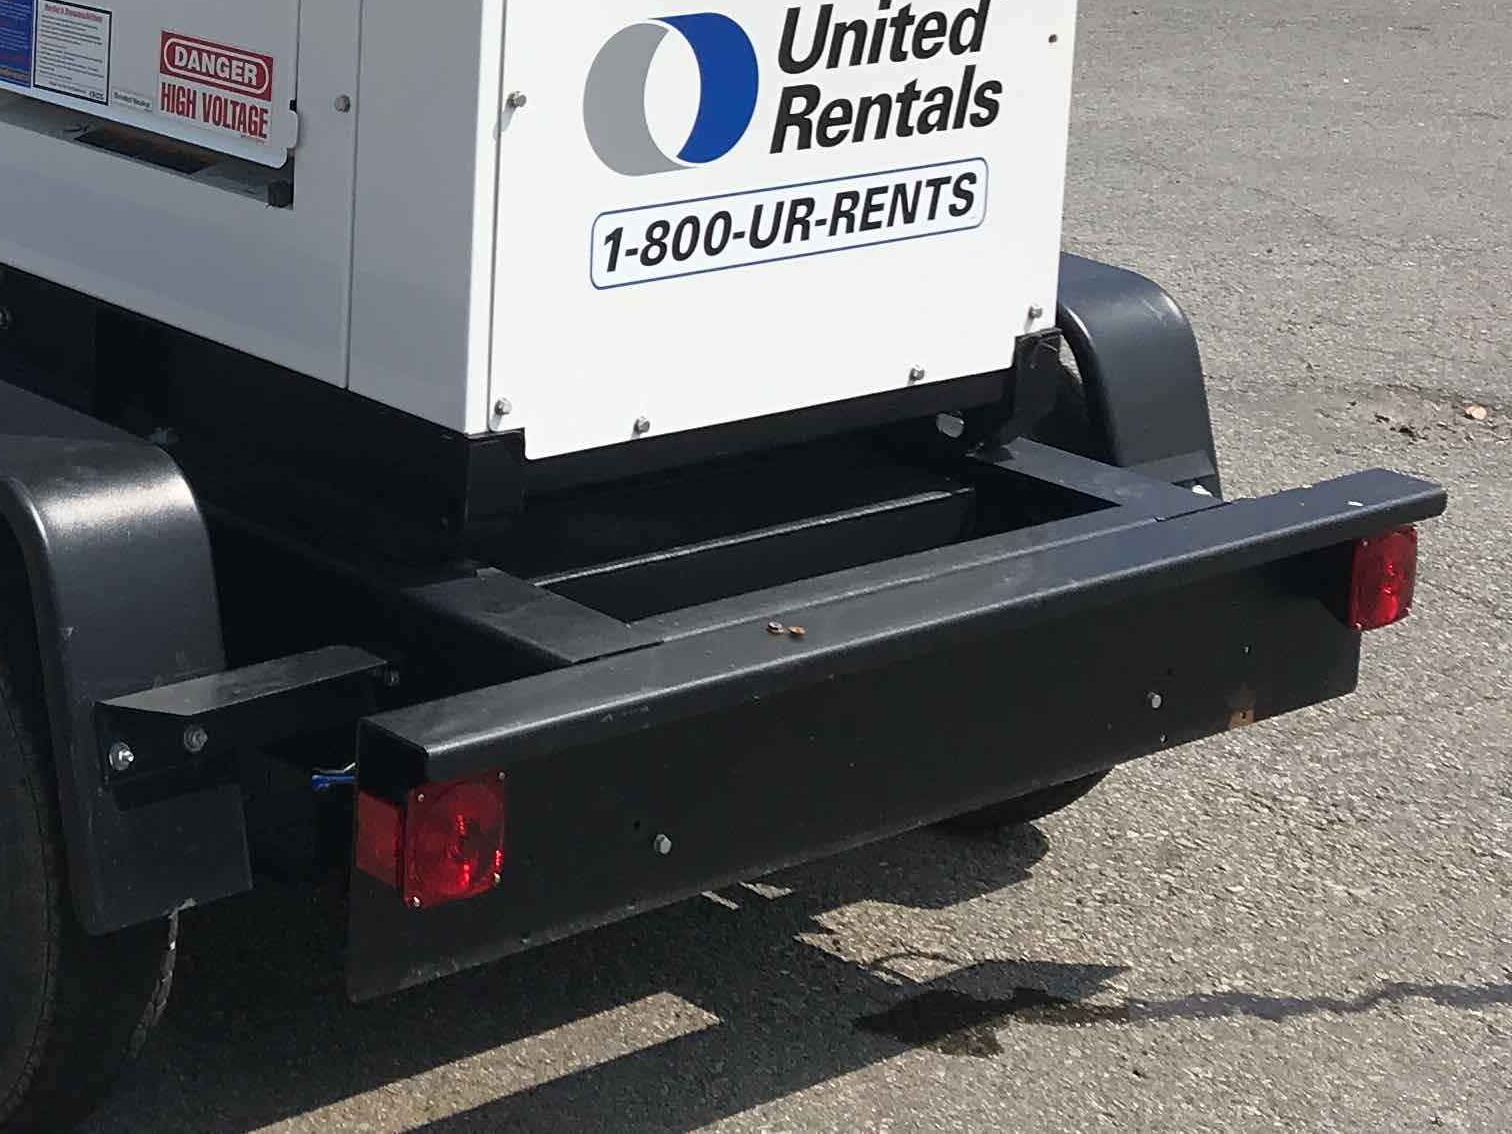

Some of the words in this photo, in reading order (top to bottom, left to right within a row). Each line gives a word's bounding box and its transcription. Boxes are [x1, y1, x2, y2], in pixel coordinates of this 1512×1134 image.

[174, 46, 257, 85] DANGER
[160, 82, 197, 119] HIGH
[202, 93, 268, 138] VOLTAGE
[770, 65, 1003, 153] Rentals
[603, 172, 977, 272] 1-800-UR-RENTS
